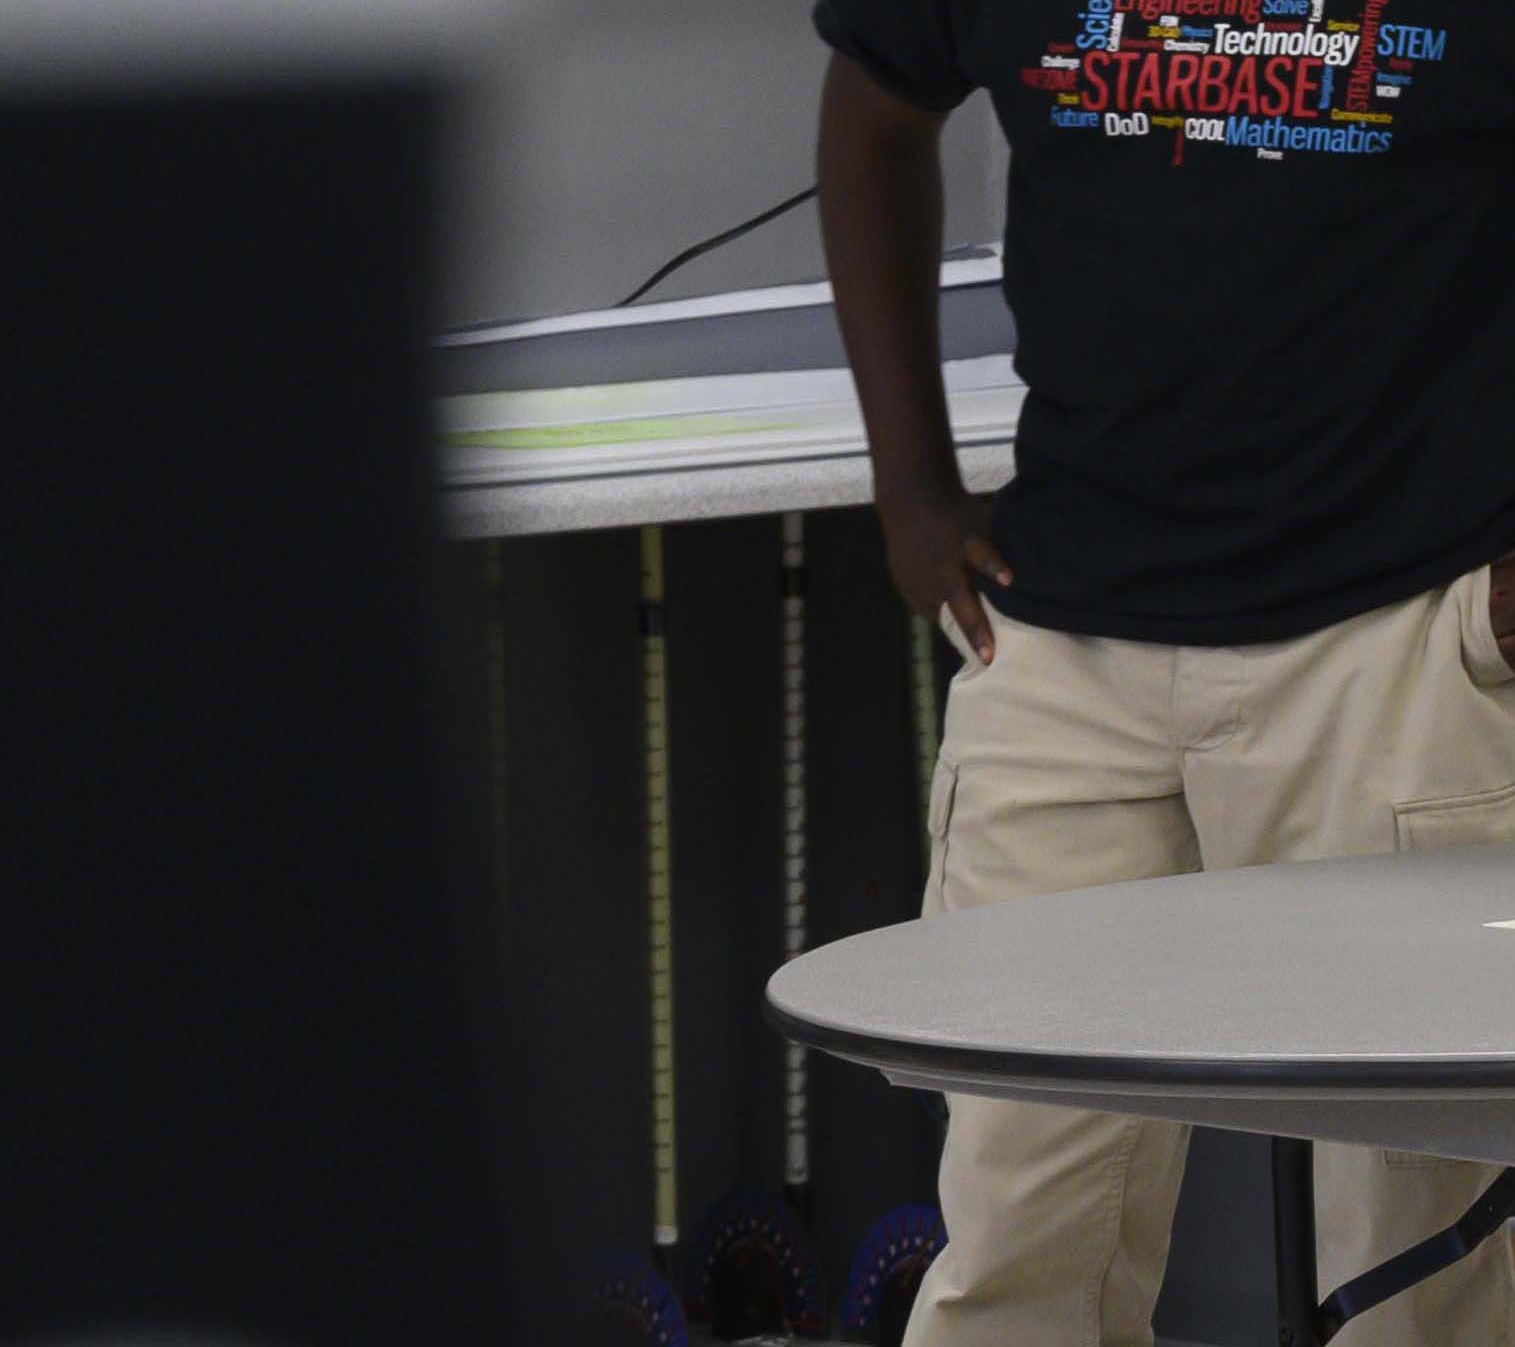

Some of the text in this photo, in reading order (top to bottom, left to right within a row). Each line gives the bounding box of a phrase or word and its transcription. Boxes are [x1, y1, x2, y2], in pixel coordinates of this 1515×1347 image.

[1214, 22, 1360, 66] Technology
[1376, 23, 1447, 61] STEM
[1082, 50, 1323, 118] STARBASE
[1104, 112, 1149, 136] DoD
[1185, 118, 1225, 141] COOL
[1224, 115, 1392, 153] Mathematics
